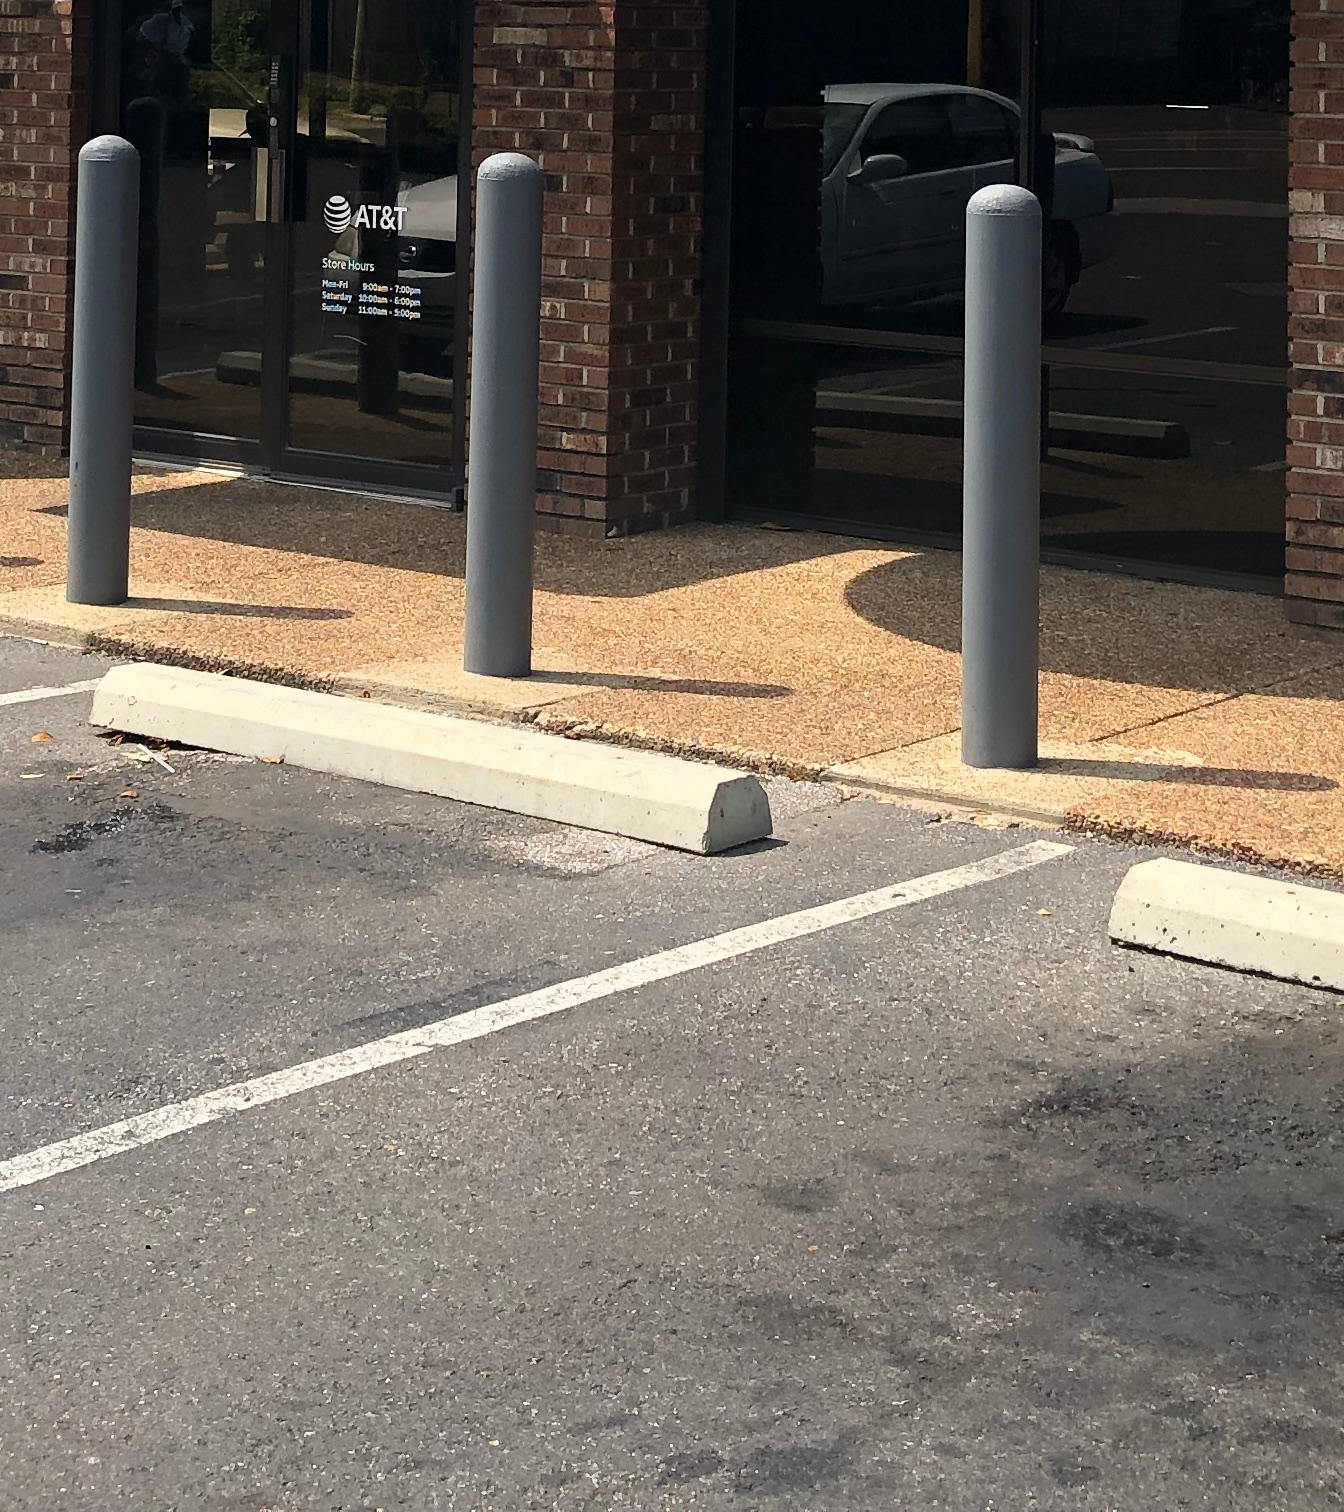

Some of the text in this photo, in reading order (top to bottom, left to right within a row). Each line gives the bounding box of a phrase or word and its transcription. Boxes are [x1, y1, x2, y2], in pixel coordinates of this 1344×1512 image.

[354, 204, 408, 231] AT&T
[321, 257, 375, 272] Store Hours
[362, 282, 389, 293] 9:00am
[394, 285, 421, 296] 7:00pm
[321, 291, 353, 303] Saturday
[358, 294, 388, 304] 10:00am
[321, 303, 347, 314] Sunday
[358, 306, 388, 316] 11:00am
